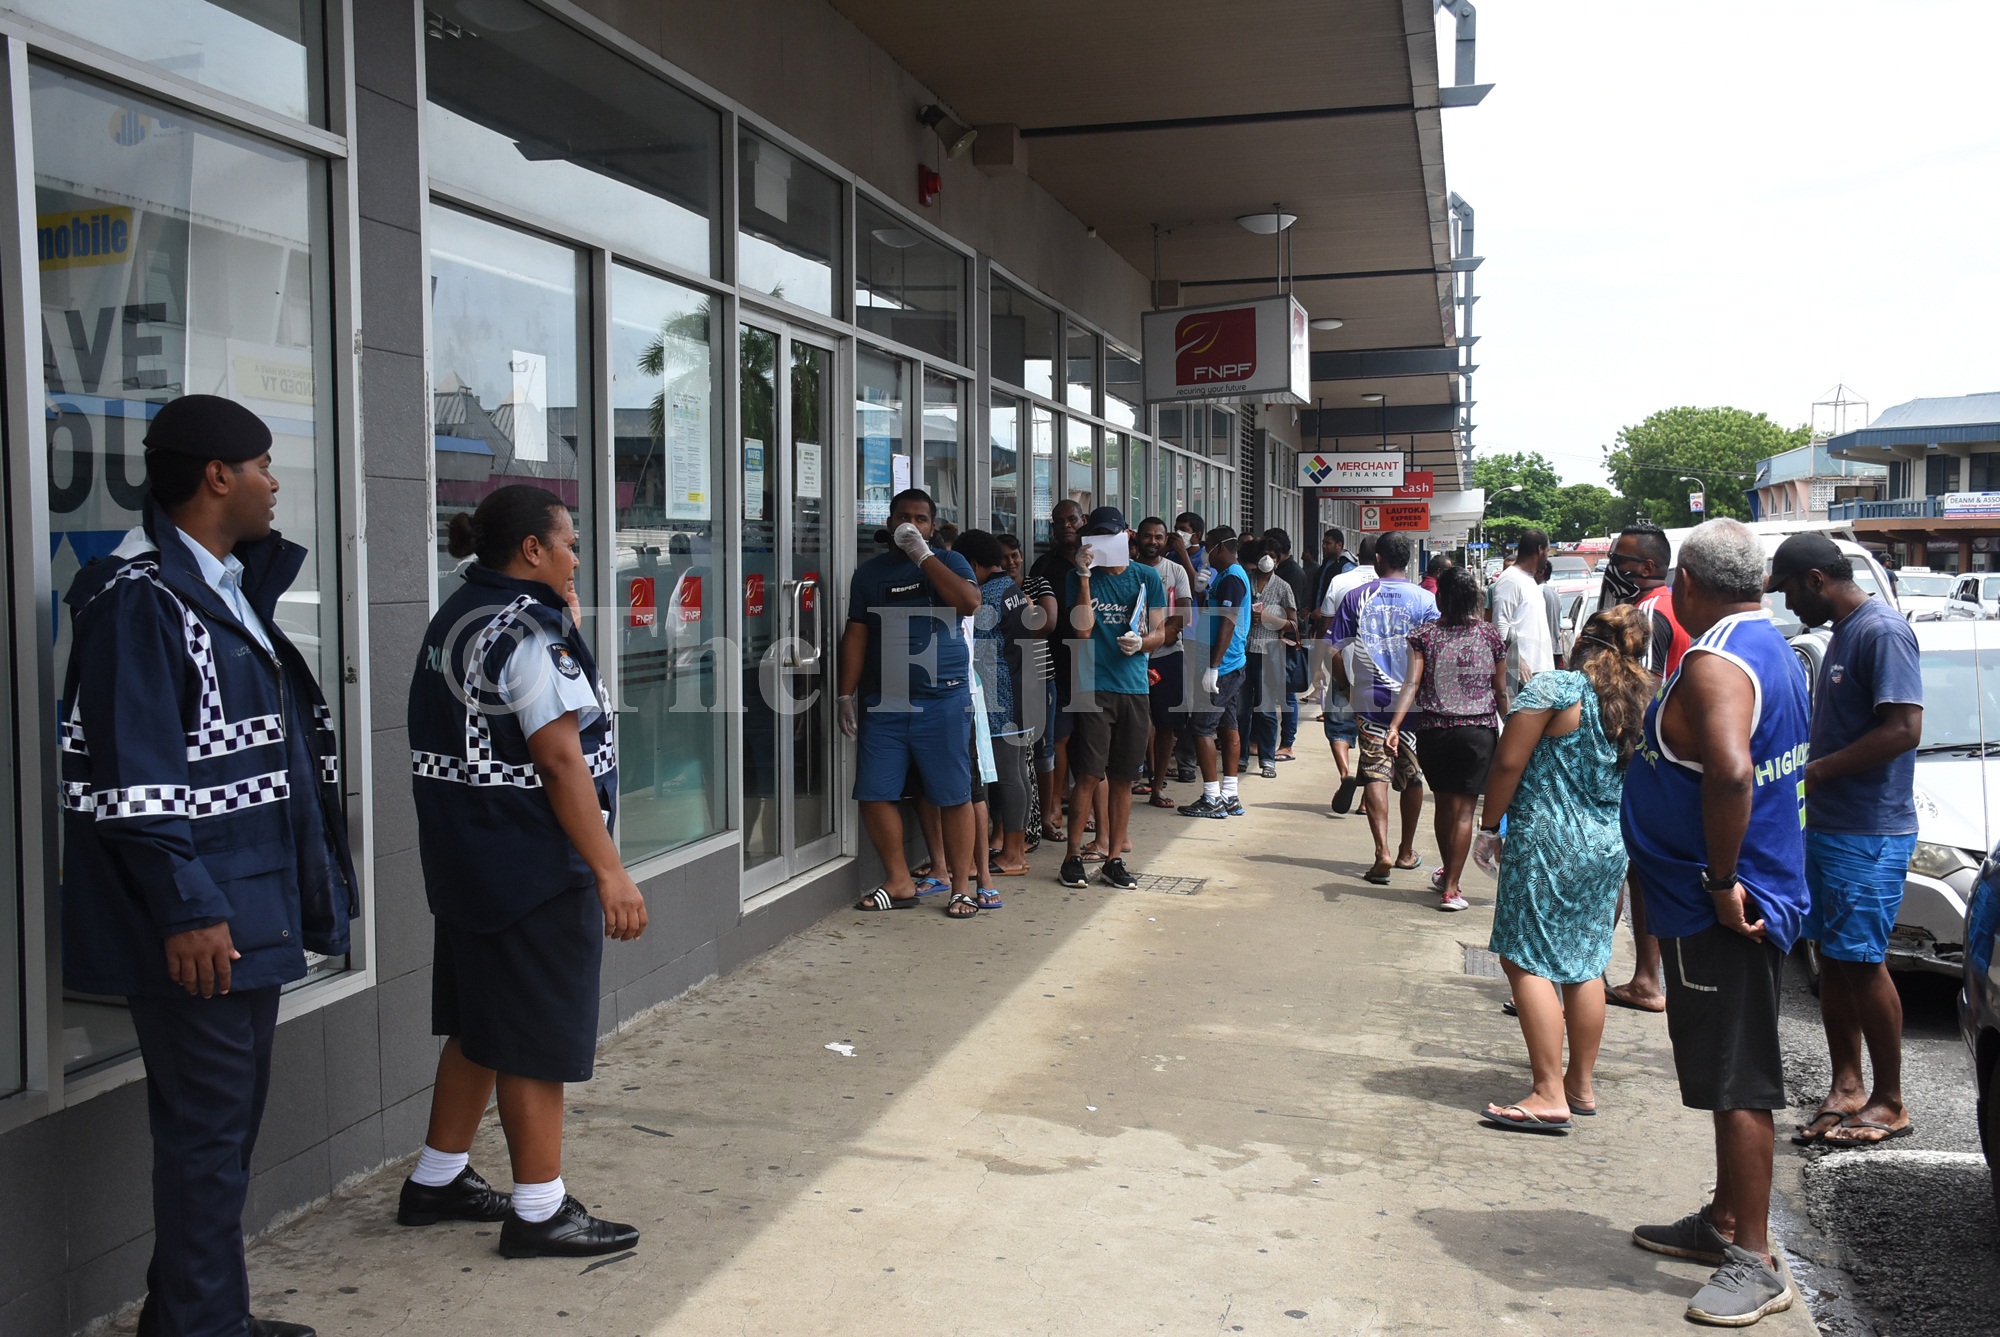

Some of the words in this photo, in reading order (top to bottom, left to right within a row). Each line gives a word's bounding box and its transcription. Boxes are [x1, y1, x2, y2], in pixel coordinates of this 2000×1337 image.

[38, 214, 128, 261] mobile
[1193, 363, 1252, 380] FNPF
[1176, 386, 1206, 396] securing
[1207, 386, 1224, 396] your
[1225, 384, 1247, 392] future
[1336, 461, 1399, 471] MERCHANT
[1400, 482, 1430, 493] Cash
[891, 582, 920, 593] RESPECT
[749, 605, 763, 614] FNPF
[1090, 597, 1129, 612] Ocean
[635, 614, 654, 625] FNPF
[684, 611, 702, 621] FNPF
